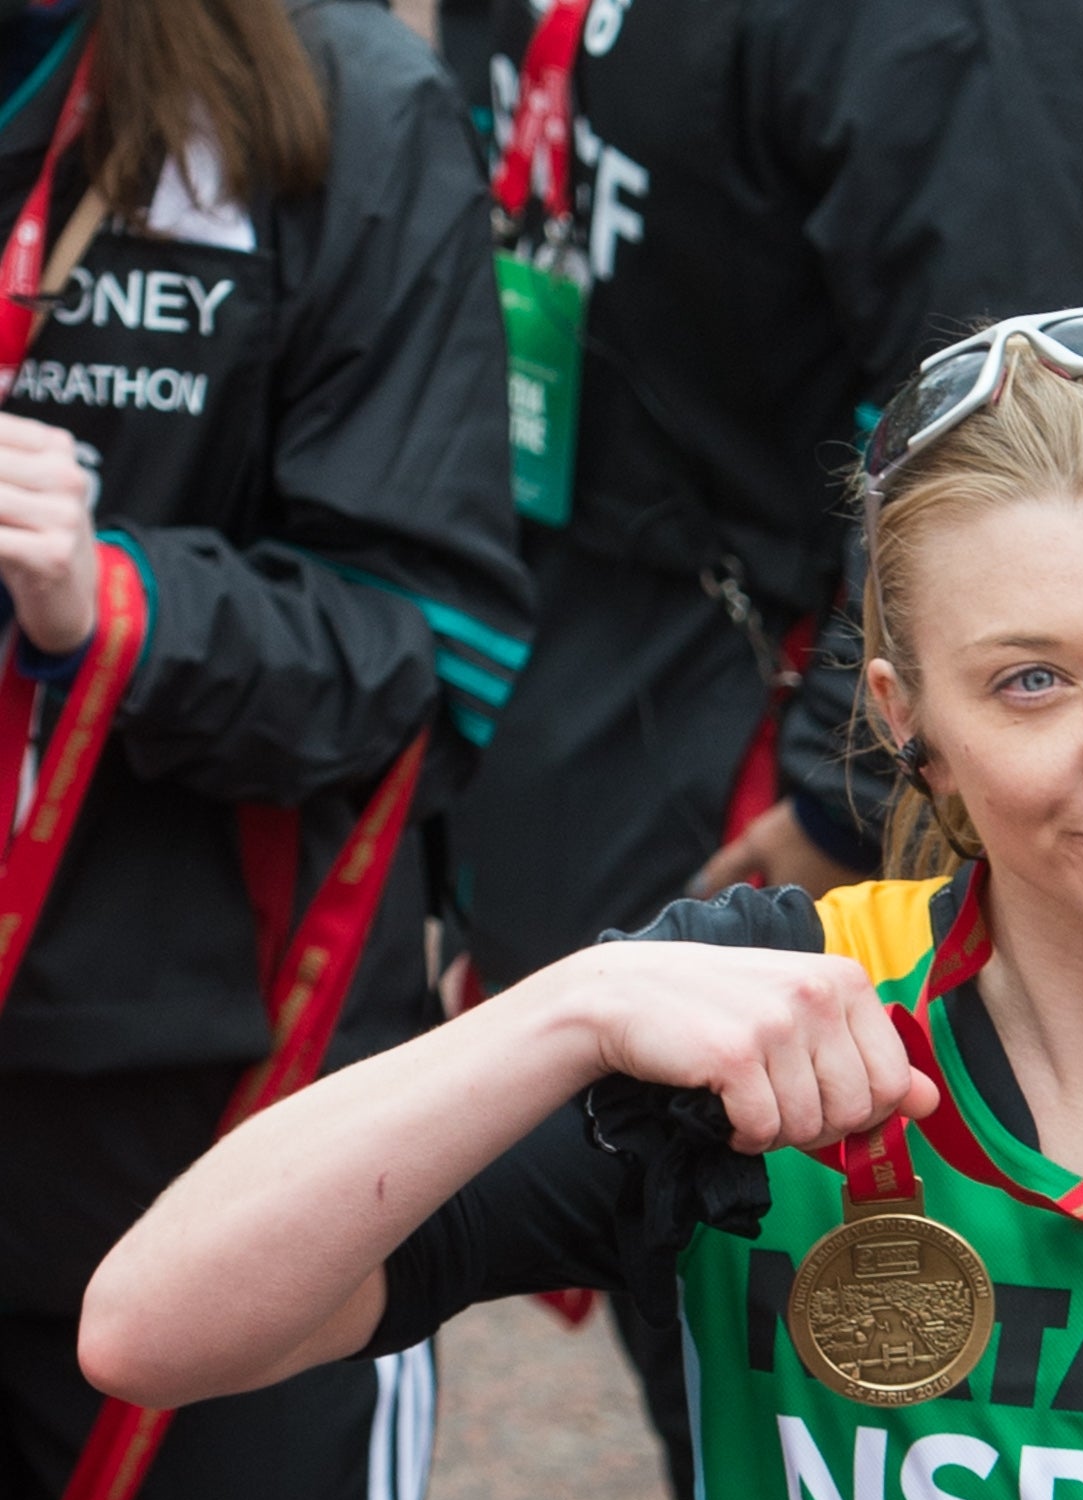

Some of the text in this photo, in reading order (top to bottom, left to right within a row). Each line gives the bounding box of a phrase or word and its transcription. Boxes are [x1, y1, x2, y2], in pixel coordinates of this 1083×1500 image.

[53, 265, 236, 336] ONEY
[11, 358, 208, 416] ARATHON
[866, 1389, 913, 1403] APRIL
